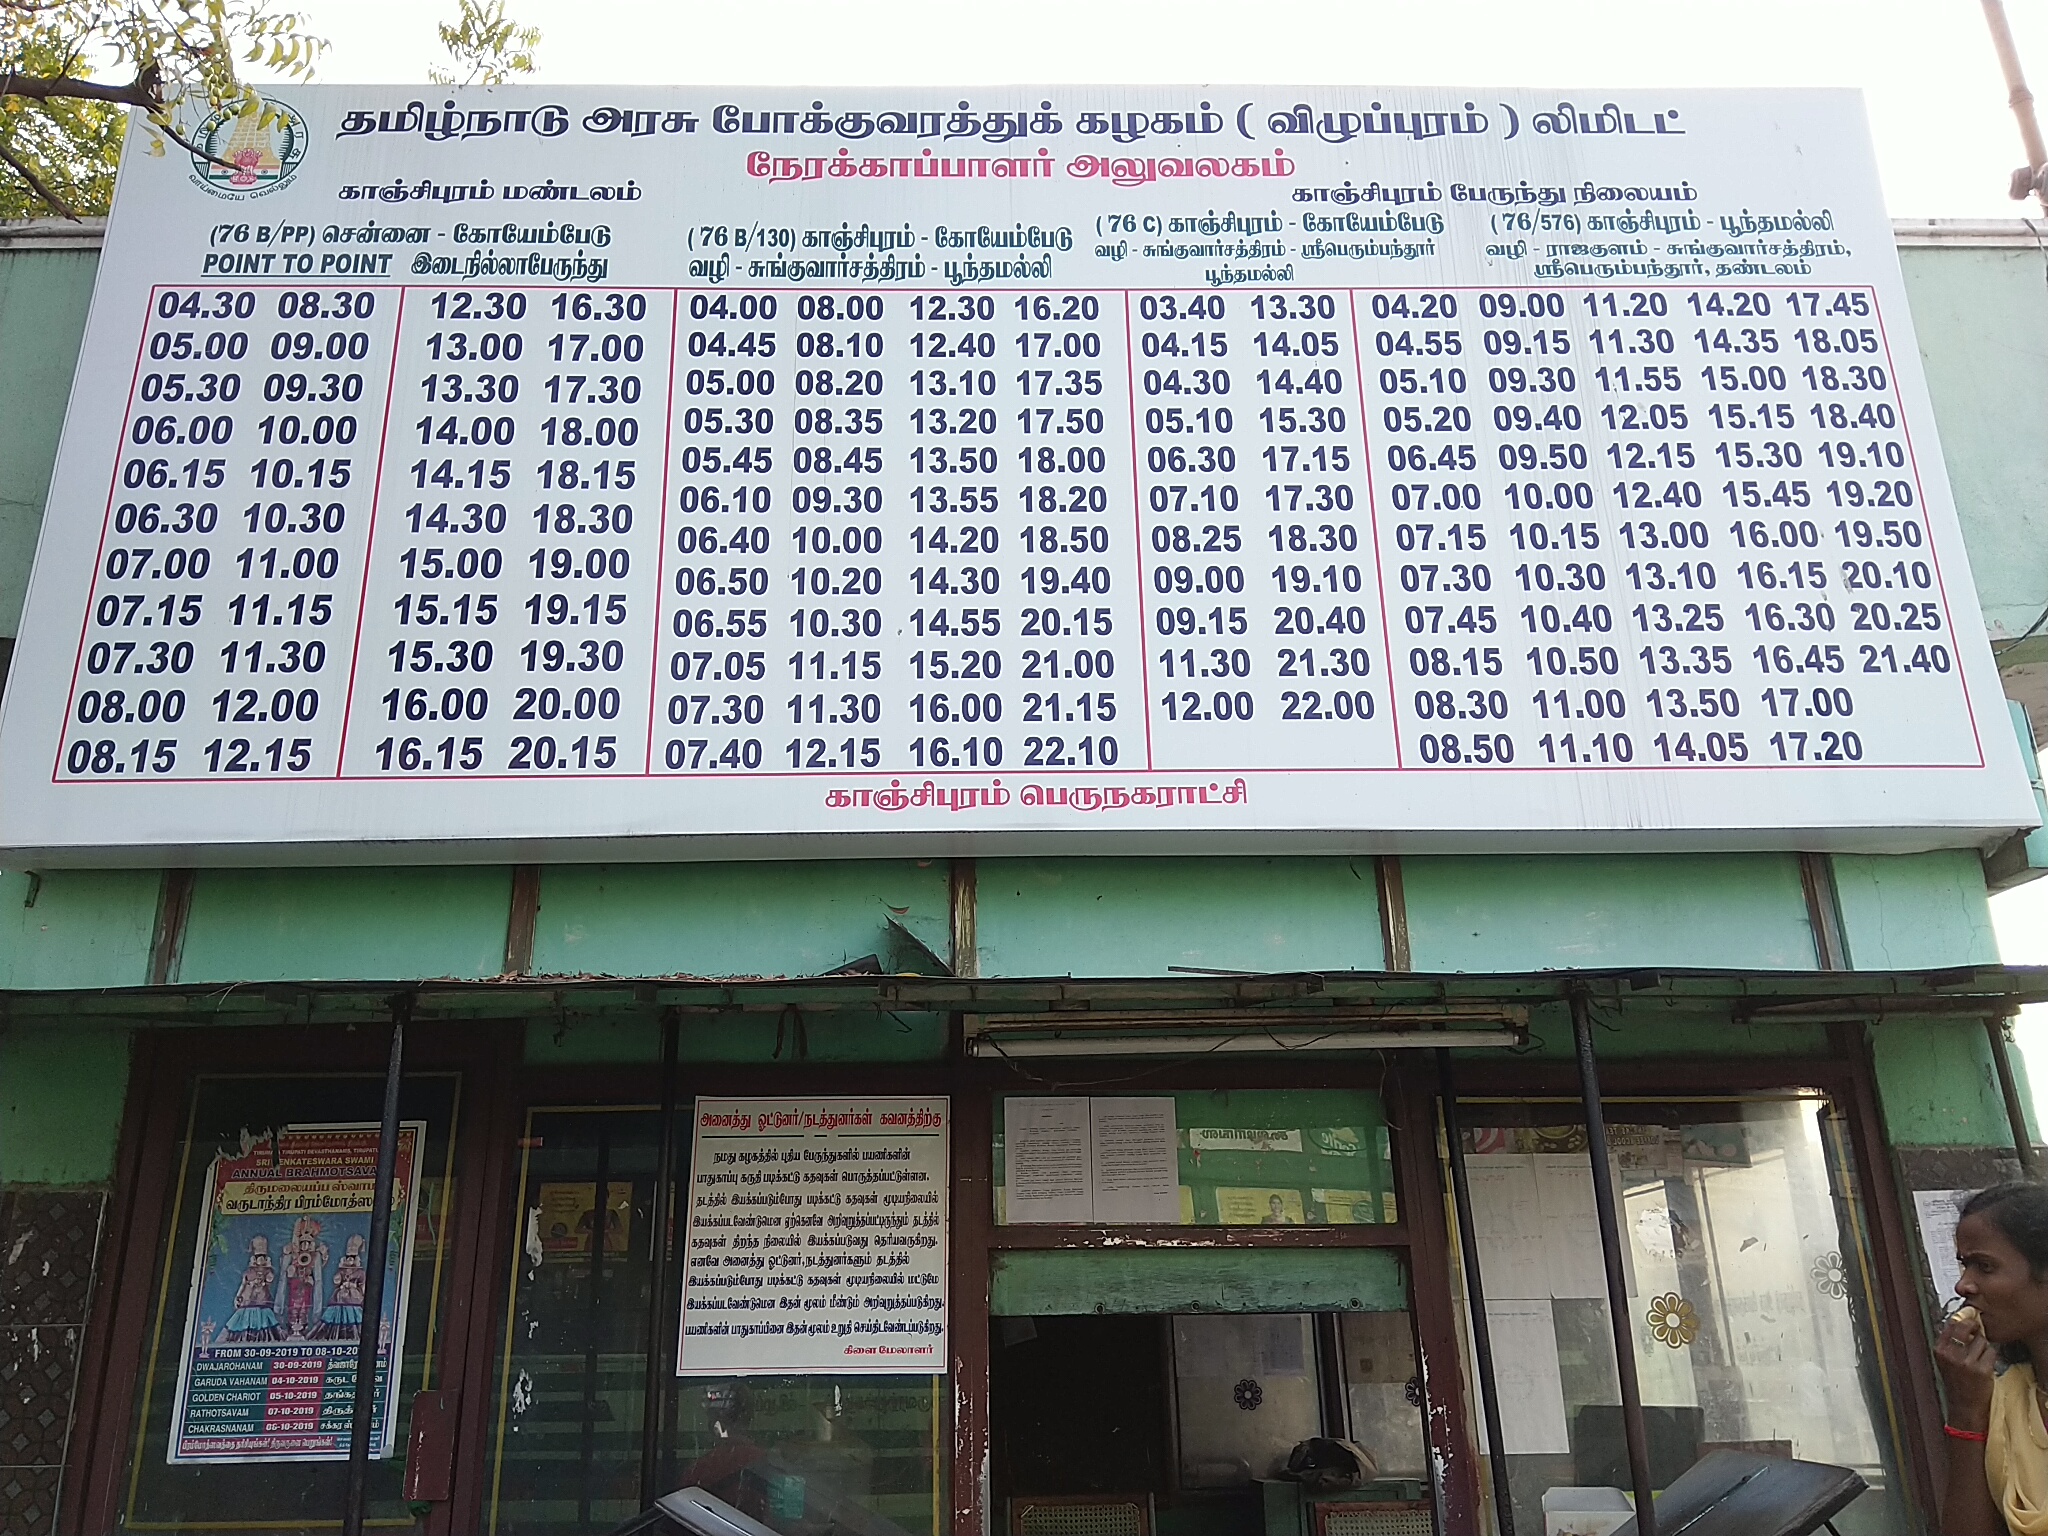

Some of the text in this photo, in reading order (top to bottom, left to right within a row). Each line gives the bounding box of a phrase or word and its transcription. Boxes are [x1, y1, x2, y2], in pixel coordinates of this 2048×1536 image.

[335, 99, 1685, 143] தமிழ்நாடு அரசு போக்குவரத்துக் கழகம் விழுப்புரம் லிமிடட்
[747, 148, 1294, 187] நேரக்காப்பாளர் அலுவலகம்
[339, 179, 641, 204] காஞ்சிபுரம் மண்டலம்
[1292, 181, 1697, 206] காஞ்சிபுரம் பேருந்து நிலையம்
[323, 221, 431, 245] சென்னை
[453, 220, 612, 249] கோயேம்பேடு
[1168, 210, 1283, 237] காஞ்சிபுரம்
[1302, 209, 1445, 235] கோயேம்பேடு
[1587, 209, 1701, 235] காஞ்சிபுரம்
[1720, 209, 1836, 238] பூந்தமல்லி
[734, 222, 796, 255] B/130)
[802, 224, 916, 251] காஞ்சிபுரம்
[935, 223, 1073, 252] கோயேம்பேடு
[1095, 240, 1129, 259] வழி
[1143, 239, 1286, 260] சுங்குவார்சத்திரம்
[1485, 240, 1528, 260] வழி
[1546, 239, 1648, 259] ராஜகுளம்
[202, 254, 278, 276] POINT
[284, 254, 314, 276] TO
[319, 254, 393, 276] POINT
[689, 254, 1052, 285] வழி சுங்குவார்சத்திரம் பூந்தமல்லி
[1205, 264, 1295, 287] பூந்தமல்லி
[1716, 259, 1812, 278] தண்டலம்
[159, 292, 374, 318] 04.30 08.30
[432, 292, 646, 320] 12.30 16.30
[691, 295, 1098, 320] 04.00 08.00 12.30 16.20
[1141, 295, 1334, 320] 03.40 13.30
[1372, 293, 1869, 318] 04.20 09.00 11.20 14.20 17.45
[683, 447, 1105, 473] 05.45 08.45 13.50 18.00
[1148, 446, 1349, 472] 06.30 17.15
[1388, 442, 1904, 471] 06.45 09.50 12.15 15.30 19.10
[124, 459, 351, 488] 06.15 10.15
[411, 459, 635, 489] 14.15 18.15
[68, 738, 311, 772] 08.15 12.15
[376, 736, 616, 770] 16.15 20.15
[666, 736, 1117, 769] 07.40 12.15 16.10 22.10
[1420, 732, 1862, 763] 08.50 11.10 14.05 17.20
[826, 778, 1247, 812] காஞ்சிபுரம் பெருநகராட்சி
[700, 1109, 751, 1129] அனைத்து
[879, 1107, 942, 1129] கவனத்திற்கு
[255, 1156, 374, 1167] SRI ENKATESWARA SWAMI
[713, 1151, 737, 1165] நமது
[738, 1148, 779, 1165] கழகத்தில்
[231, 1167, 282, 1179] ANNUAL
[214, 1346, 359, 1359] FROM 30-09-2019 TO 08-10-20
[196, 1361, 264, 1372] DWAJAROHANAM
[194, 1376, 228, 1387] GARUDA
[228, 1376, 268, 1387] VAHANAM
[191, 1392, 226, 1403] GOLDEN
[226, 1391, 262, 1402] CHARIOT
[189, 1407, 250, 1419] RATHOTSAVAM
[187, 1423, 255, 1434] CHAKRASNANAM
